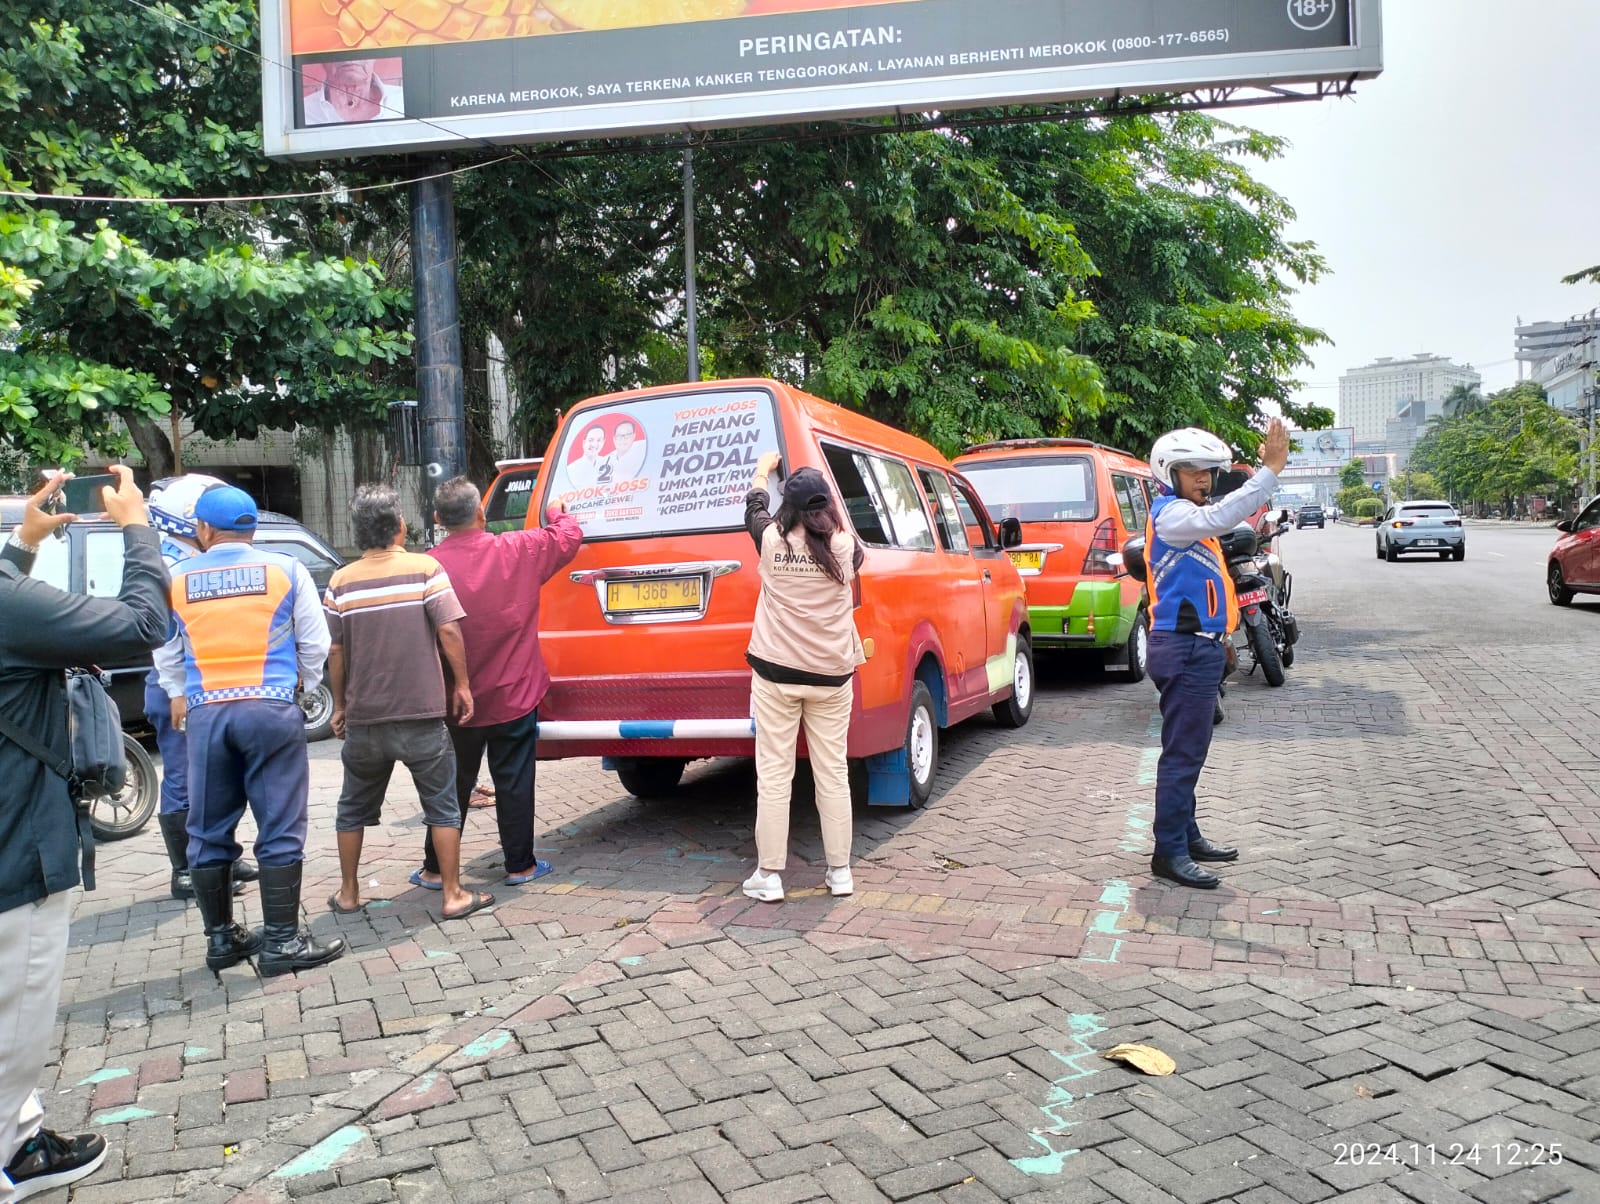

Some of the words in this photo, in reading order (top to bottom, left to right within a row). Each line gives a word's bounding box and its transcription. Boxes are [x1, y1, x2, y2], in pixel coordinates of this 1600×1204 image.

[1293, 0, 1329, 17] 18+
[739, 25, 902, 57] PERINGATAN:
[450, 92, 506, 108] KARENA
[509, 86, 583, 103] MEROKOK,
[586, 83, 622, 96] SAYA
[626, 78, 691, 93] TERKENA
[695, 71, 753, 87] KANKER
[757, 61, 873, 81] TENGGOROKAN.
[877, 54, 945, 72] LAYANAN
[949, 48, 1025, 66] BERHENTI
[1029, 40, 1107, 58] MEROKOK
[1111, 28, 1229, 53] (0800-177-6565)
[674, 400, 757, 421] YOYOK-JOSS
[671, 412, 756, 438] MENANG
[662, 429, 760, 457] BANTUAN
[660, 446, 758, 478] MODAL
[658, 475, 703, 492] UMKM
[705, 467, 757, 485] RT/RW
[657, 490, 698, 505] TANPA
[699, 481, 753, 498] AGUNAN
[187, 566, 265, 593] DISHUB
[188, 590, 213, 600] KOTA
[216, 584, 266, 596] SEMARANG
[611, 584, 619, 602] H
[636, 583, 668, 600] 1366
